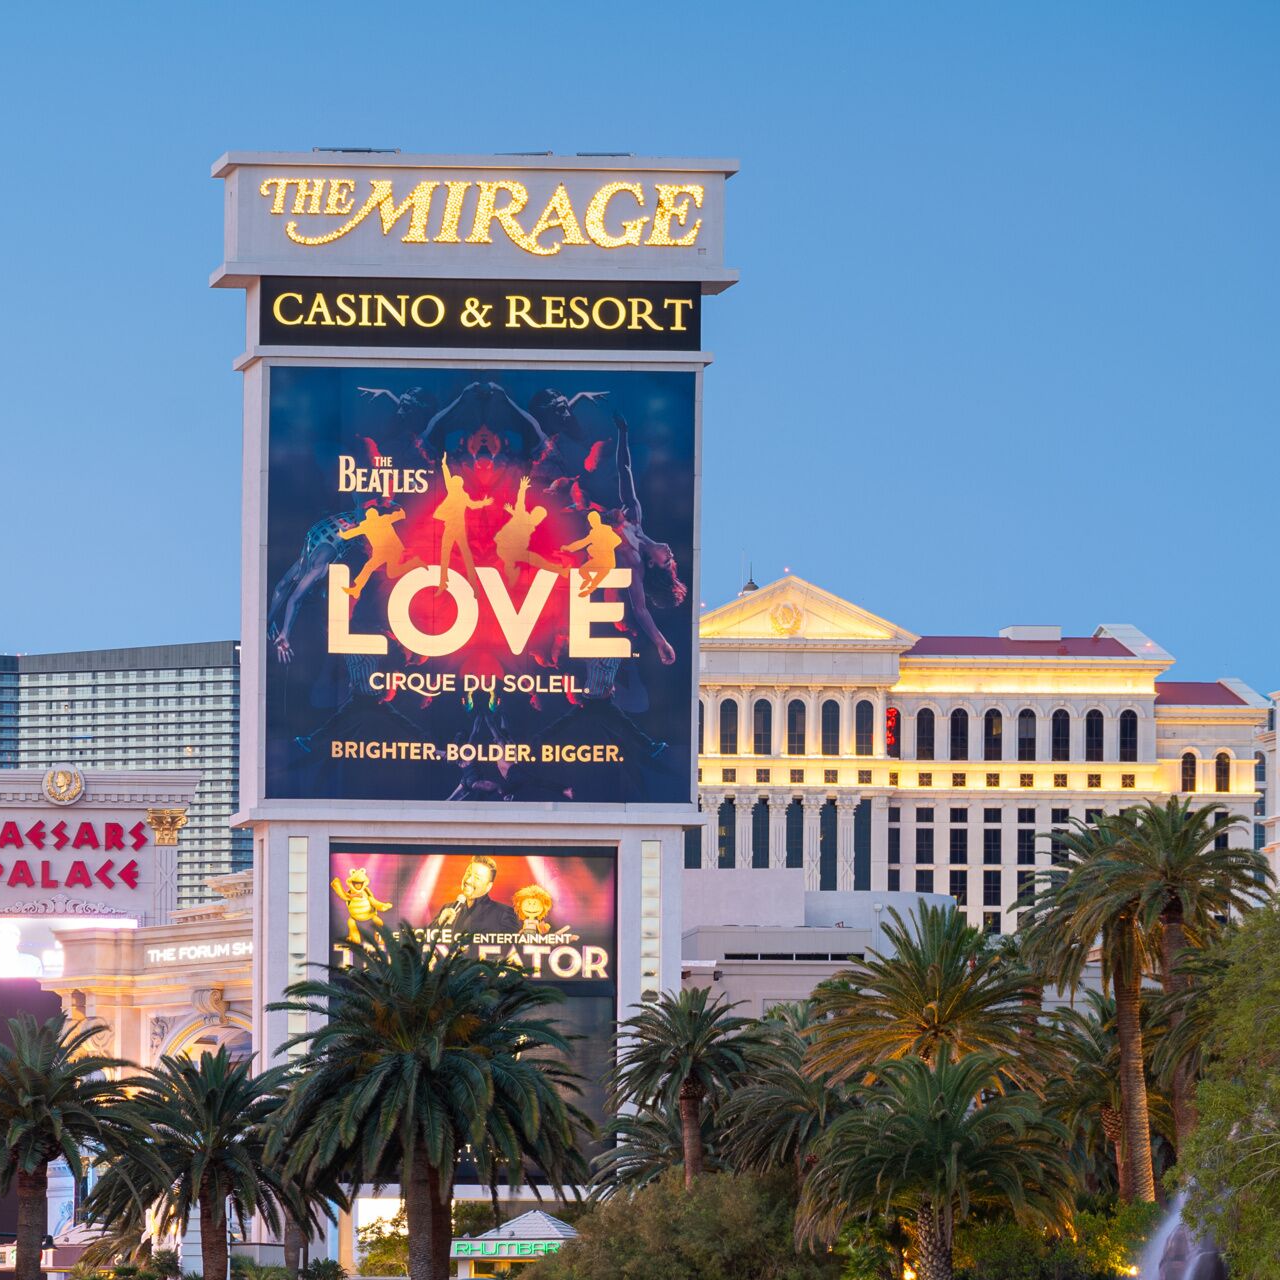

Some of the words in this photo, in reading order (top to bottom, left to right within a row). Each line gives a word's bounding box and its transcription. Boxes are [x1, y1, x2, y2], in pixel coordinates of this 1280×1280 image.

[259, 177, 356, 215] THE
[286, 179, 705, 256] MIRAGE
[272, 291, 445, 328] CASINO
[459, 296, 493, 328] &
[505, 294, 693, 331] RESORT
[374, 456, 393, 467] THE
[328, 563, 632, 658] LOVE
[368, 672, 456, 697] CIRQUE
[463, 674, 497, 692] DU
[503, 675, 583, 693] SOLEIL
[331, 741, 441, 761] BRIGHTER.
[446, 743, 536, 762] BOLDER.
[541, 744, 624, 763] BIGGER.
[408, 928, 452, 943] OICE
[473, 932, 572, 944] ENTERTAINMENT
[147, 947, 177, 963] THE
[178, 943, 230, 960] FORUM
[454, 1241, 561, 1256] RHUMBAR
